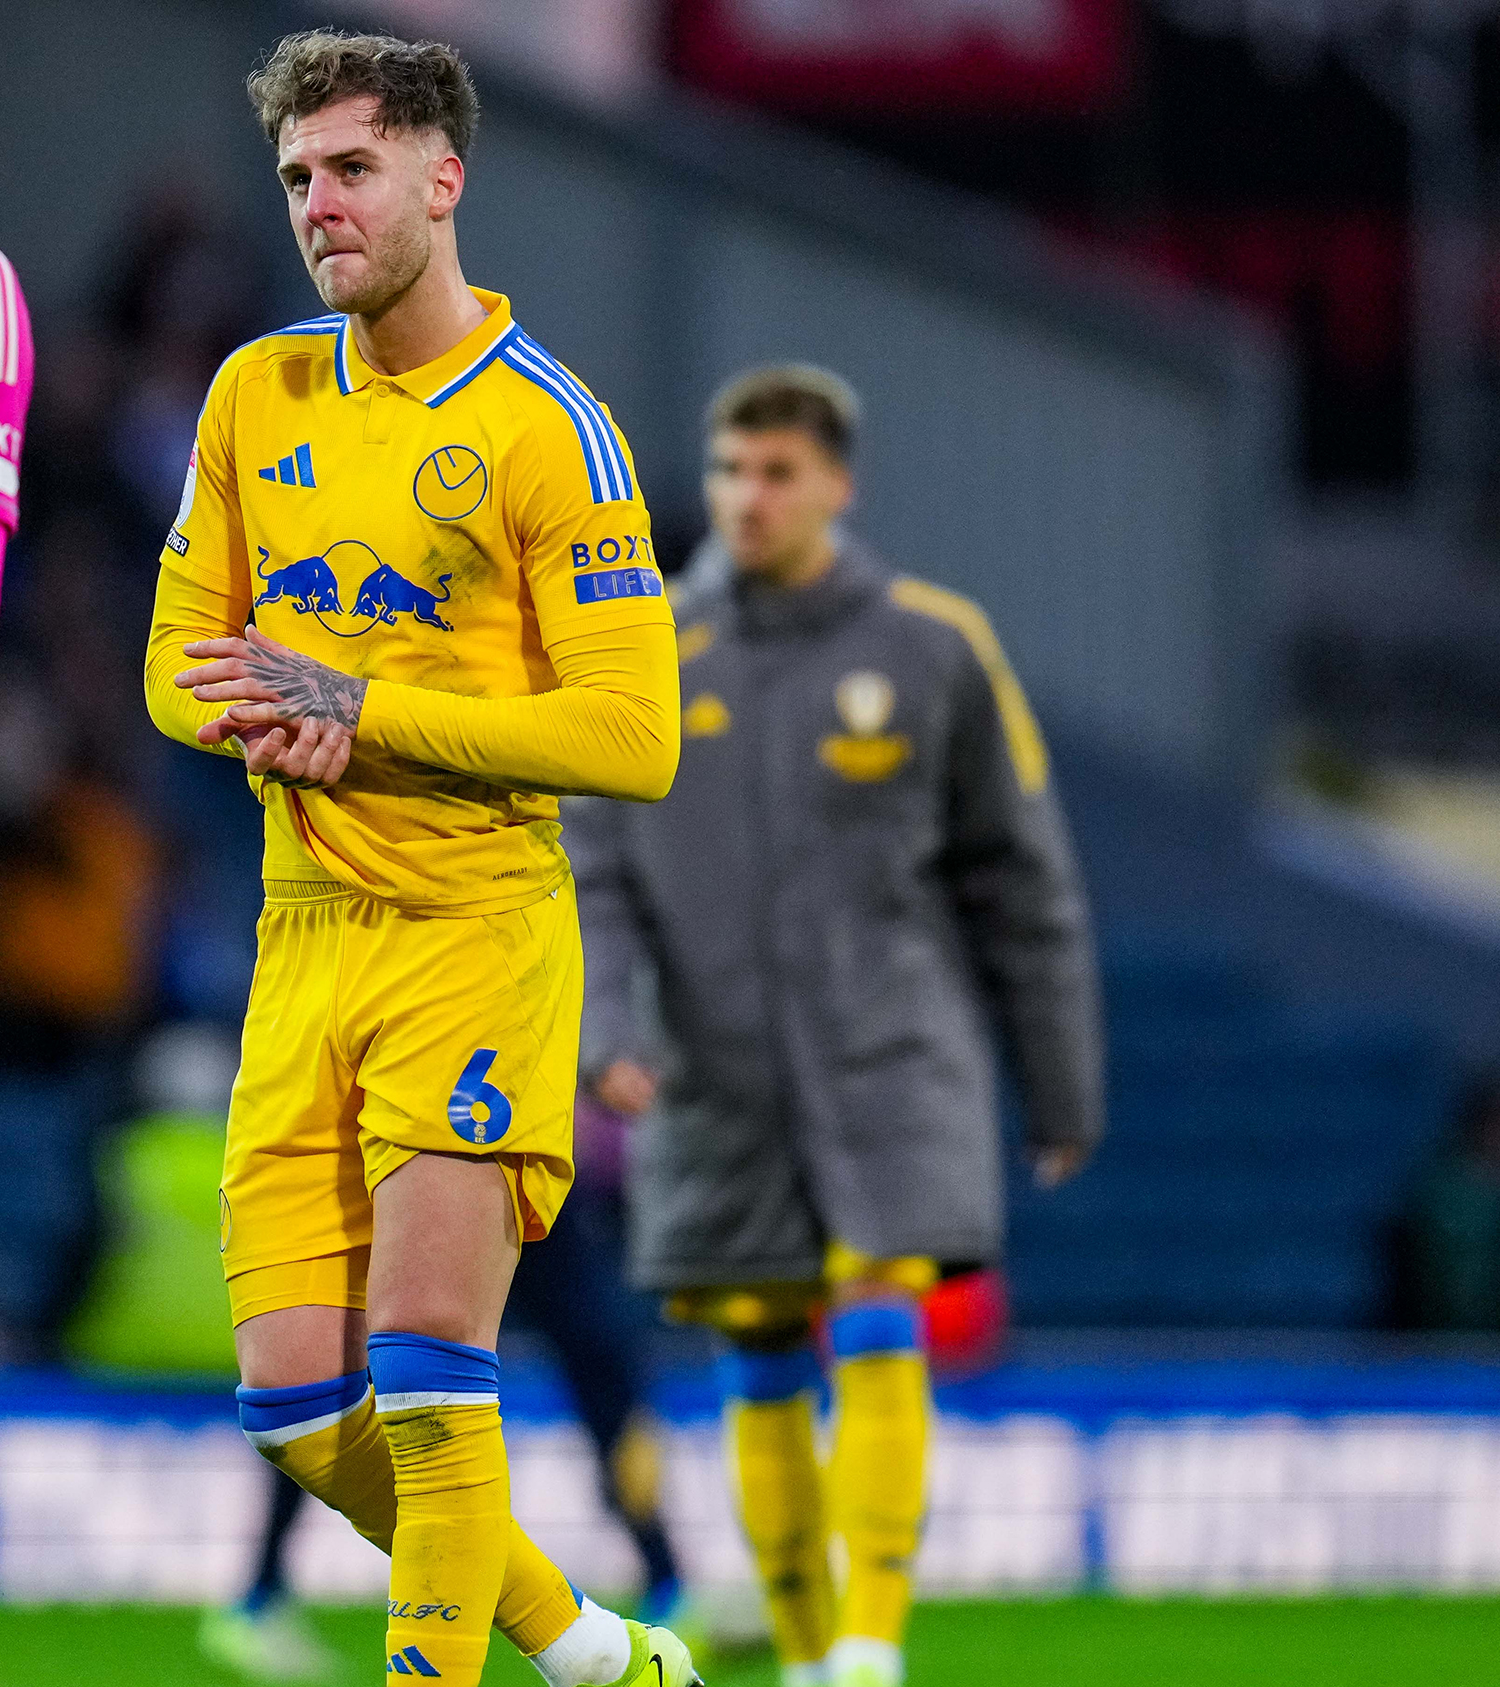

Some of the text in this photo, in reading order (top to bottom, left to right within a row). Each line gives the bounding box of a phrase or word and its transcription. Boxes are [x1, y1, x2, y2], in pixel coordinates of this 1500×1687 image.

[571, 535, 652, 568] BOXT
[592, 571, 653, 598] LIFE
[492, 867, 528, 881] AEROREADY
[447, 1047, 513, 1145] 6
